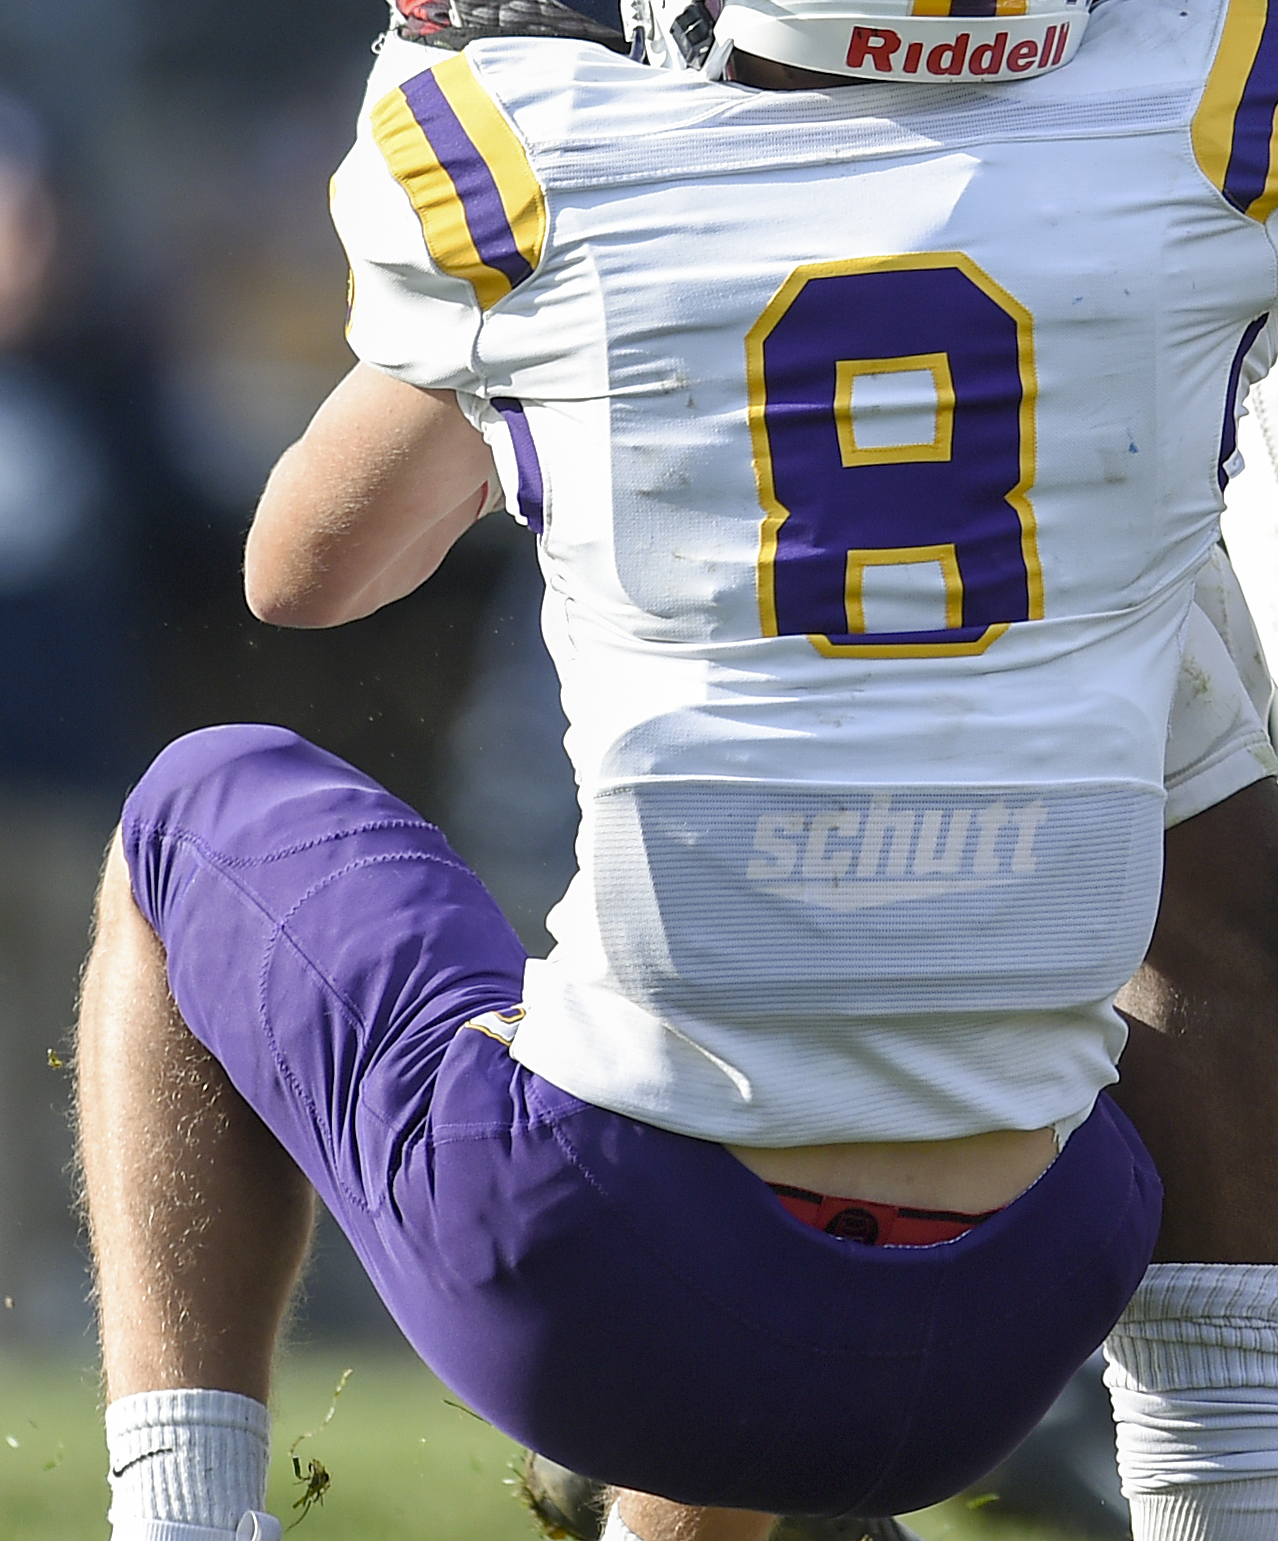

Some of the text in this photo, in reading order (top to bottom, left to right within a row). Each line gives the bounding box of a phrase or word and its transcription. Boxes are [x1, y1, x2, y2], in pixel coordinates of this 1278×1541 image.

[846, 21, 1070, 76] Riddell
[745, 251, 1044, 657] 8
[746, 793, 1049, 880] schutt
